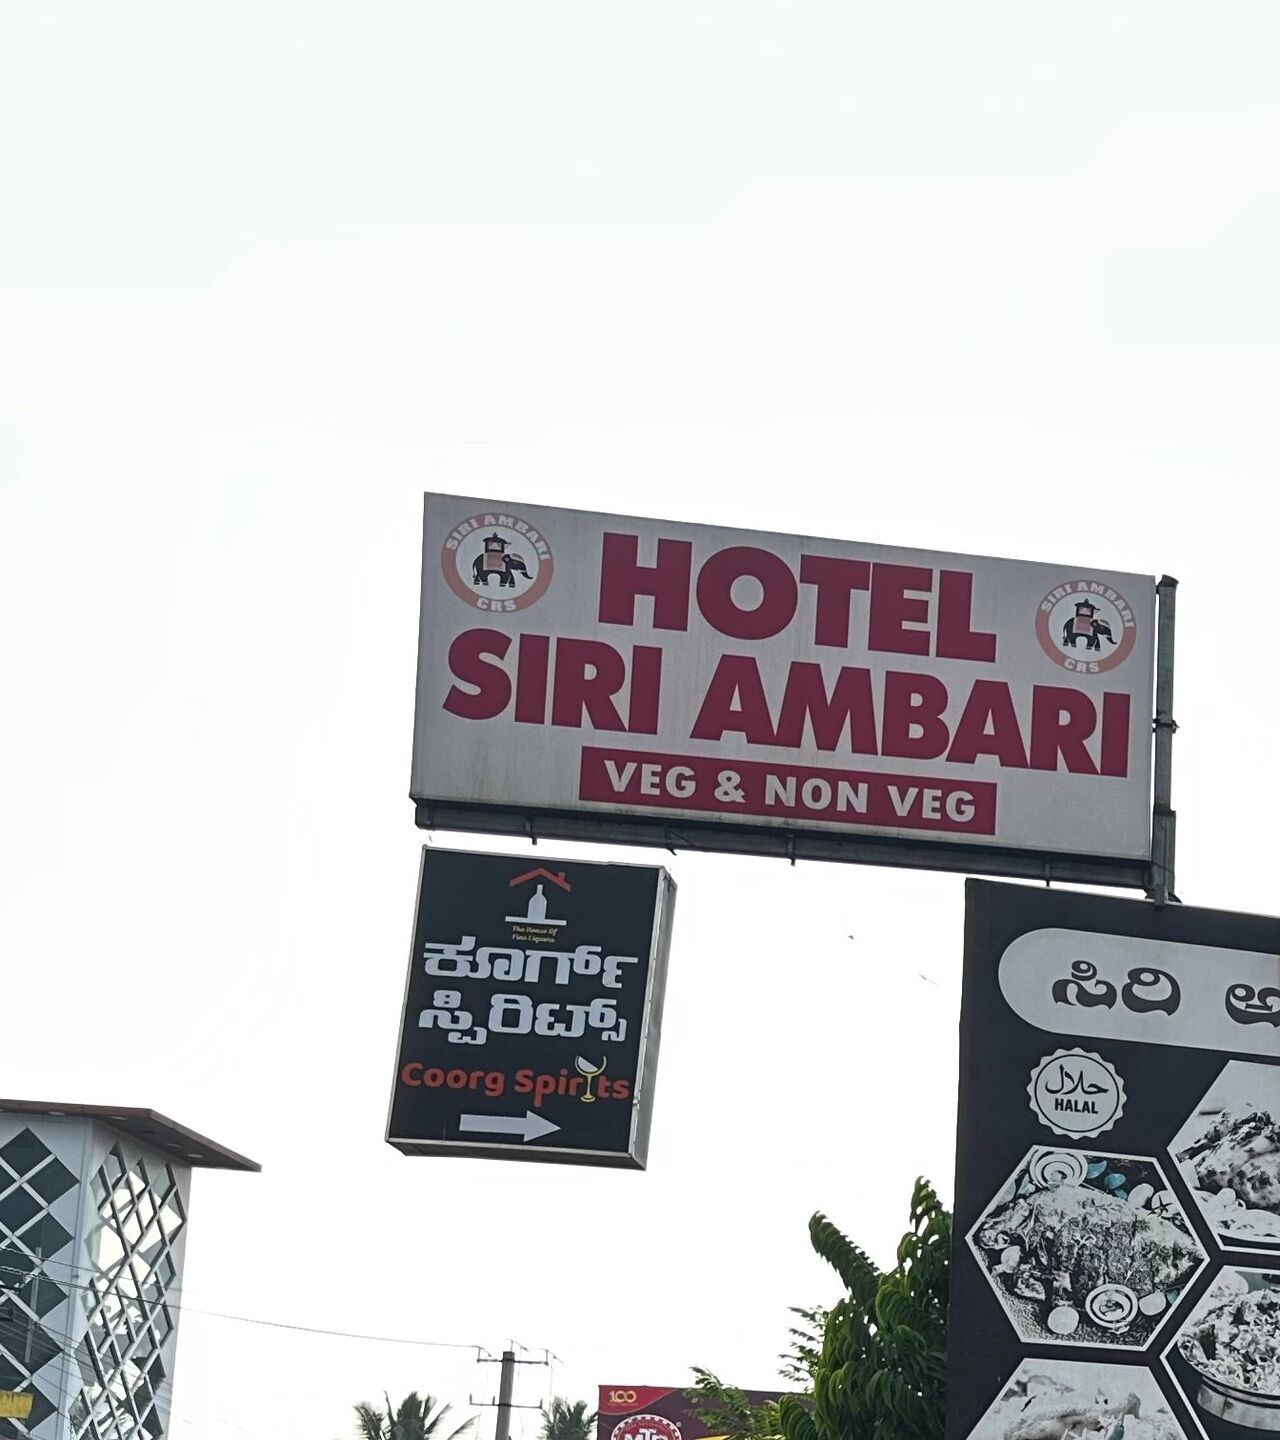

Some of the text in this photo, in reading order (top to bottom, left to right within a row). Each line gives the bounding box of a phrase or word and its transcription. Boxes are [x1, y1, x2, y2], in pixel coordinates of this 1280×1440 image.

[446, 514, 551, 561] SIRI AMBARI
[476, 597, 517, 612] CRS
[598, 531, 997, 662] HOTEL
[1040, 581, 1135, 628] SIRI AMBARI
[1063, 658, 1100, 673] CRS
[442, 627, 1131, 778] SIRI AMBARI
[604, 760, 977, 822] VEG & NON VEG
[1051, 959, 1182, 1017] ಸಿರಿ
[401, 1056, 630, 1107] Coorg Spirits
[1044, 1064, 1110, 1096] حلال
[1054, 1097, 1100, 1116] HALAL
[609, 1390, 637, 1403] 100
